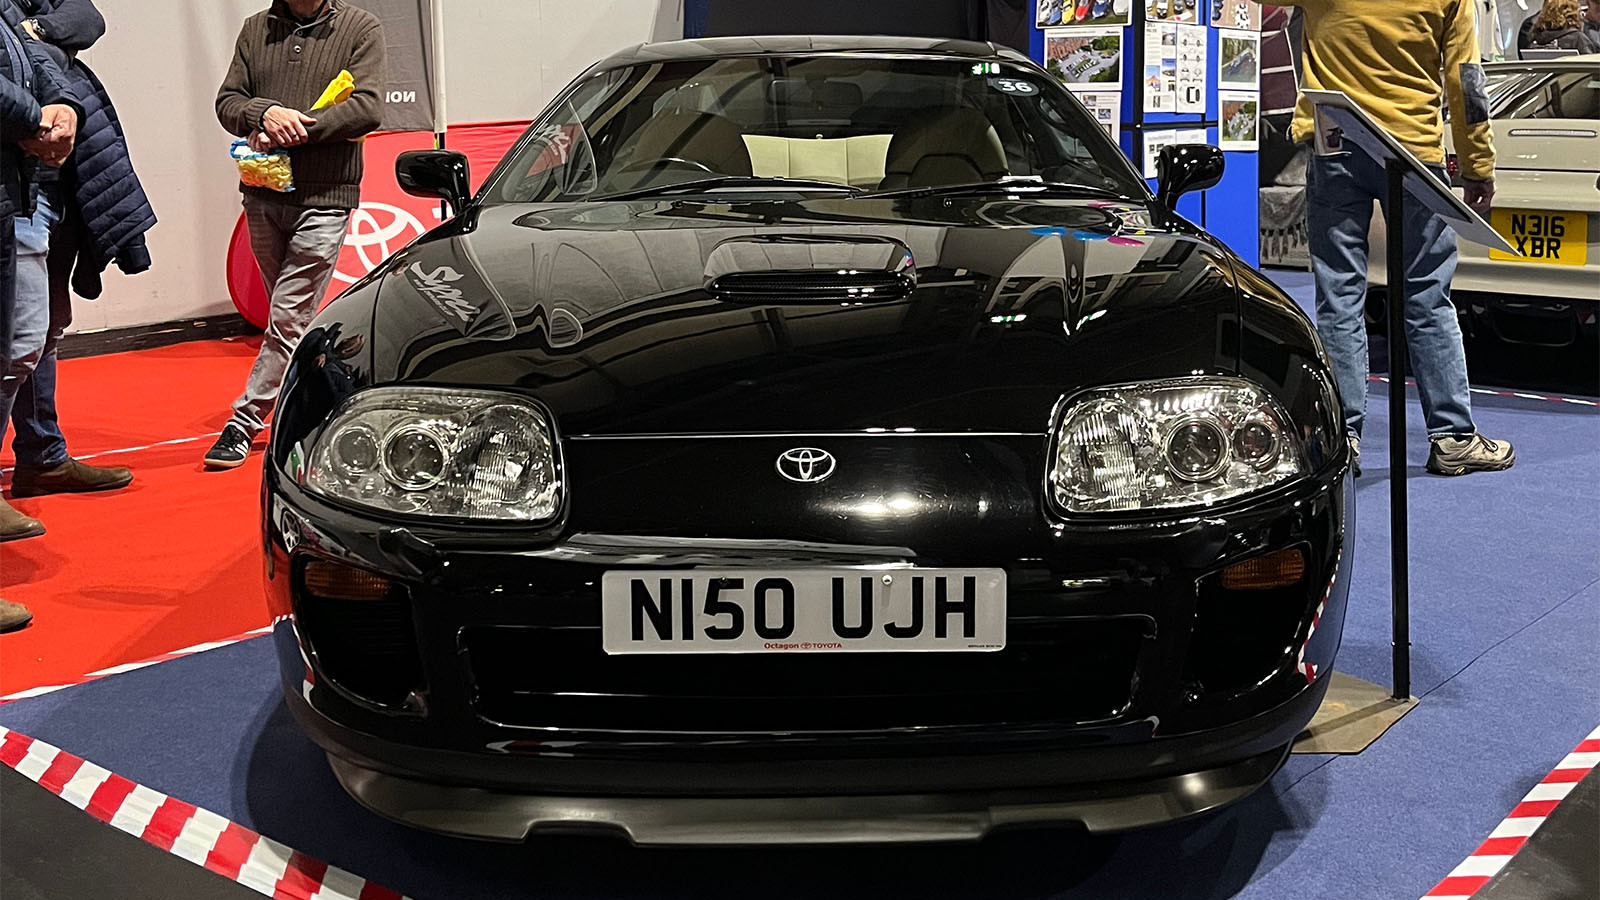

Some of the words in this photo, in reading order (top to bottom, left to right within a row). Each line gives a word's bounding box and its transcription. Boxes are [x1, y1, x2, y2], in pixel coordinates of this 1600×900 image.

[998, 80, 1033, 93] 36
[1511, 213, 1565, 237] N316
[1514, 235, 1561, 259] XBR
[630, 577, 795, 641] N150
[831, 575, 976, 640] UJH
[763, 642, 799, 650] Octagon
